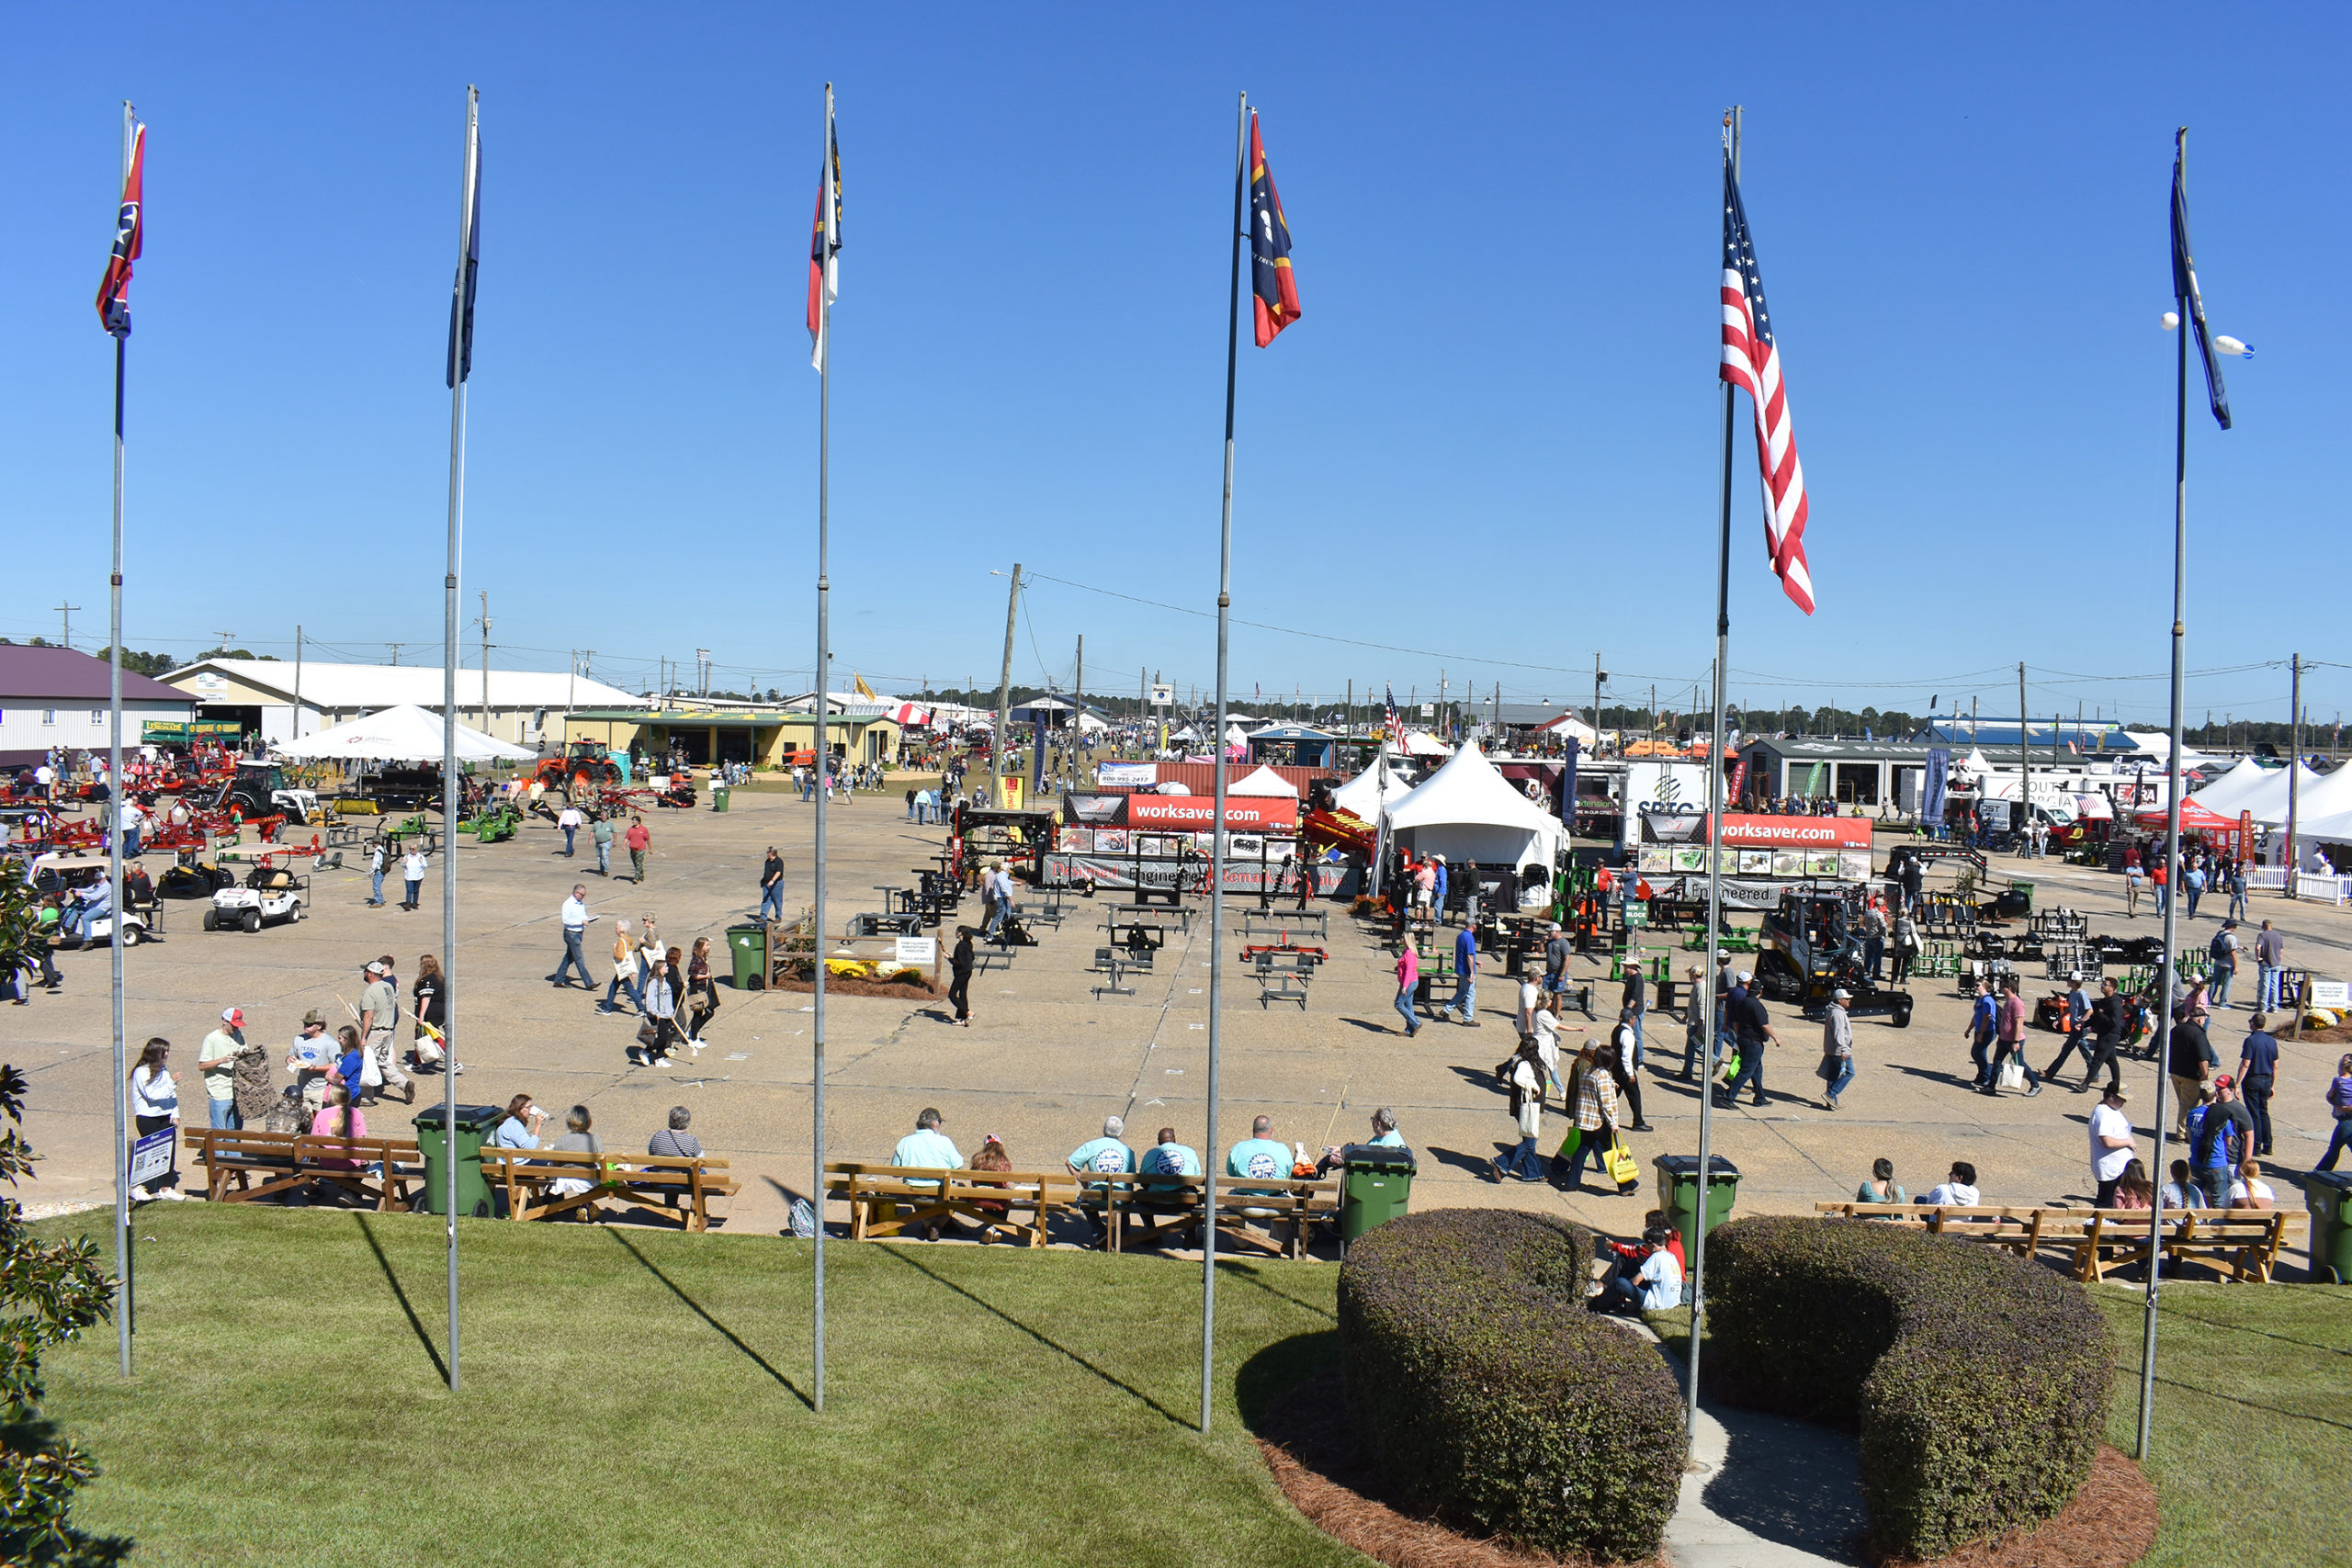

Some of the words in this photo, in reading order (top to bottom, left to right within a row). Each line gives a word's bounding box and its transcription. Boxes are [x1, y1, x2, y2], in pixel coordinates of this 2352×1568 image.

[1731, 764, 1744, 802] SHUTTLE
[2018, 781, 2067, 793] SOUT
[2007, 795, 2073, 807] RGIA
[2116, 785, 2154, 803] EXRA
[1574, 799, 1612, 808] extension
[1136, 804, 1260, 820] worksave.com
[1691, 884, 1773, 901] Enneered.
